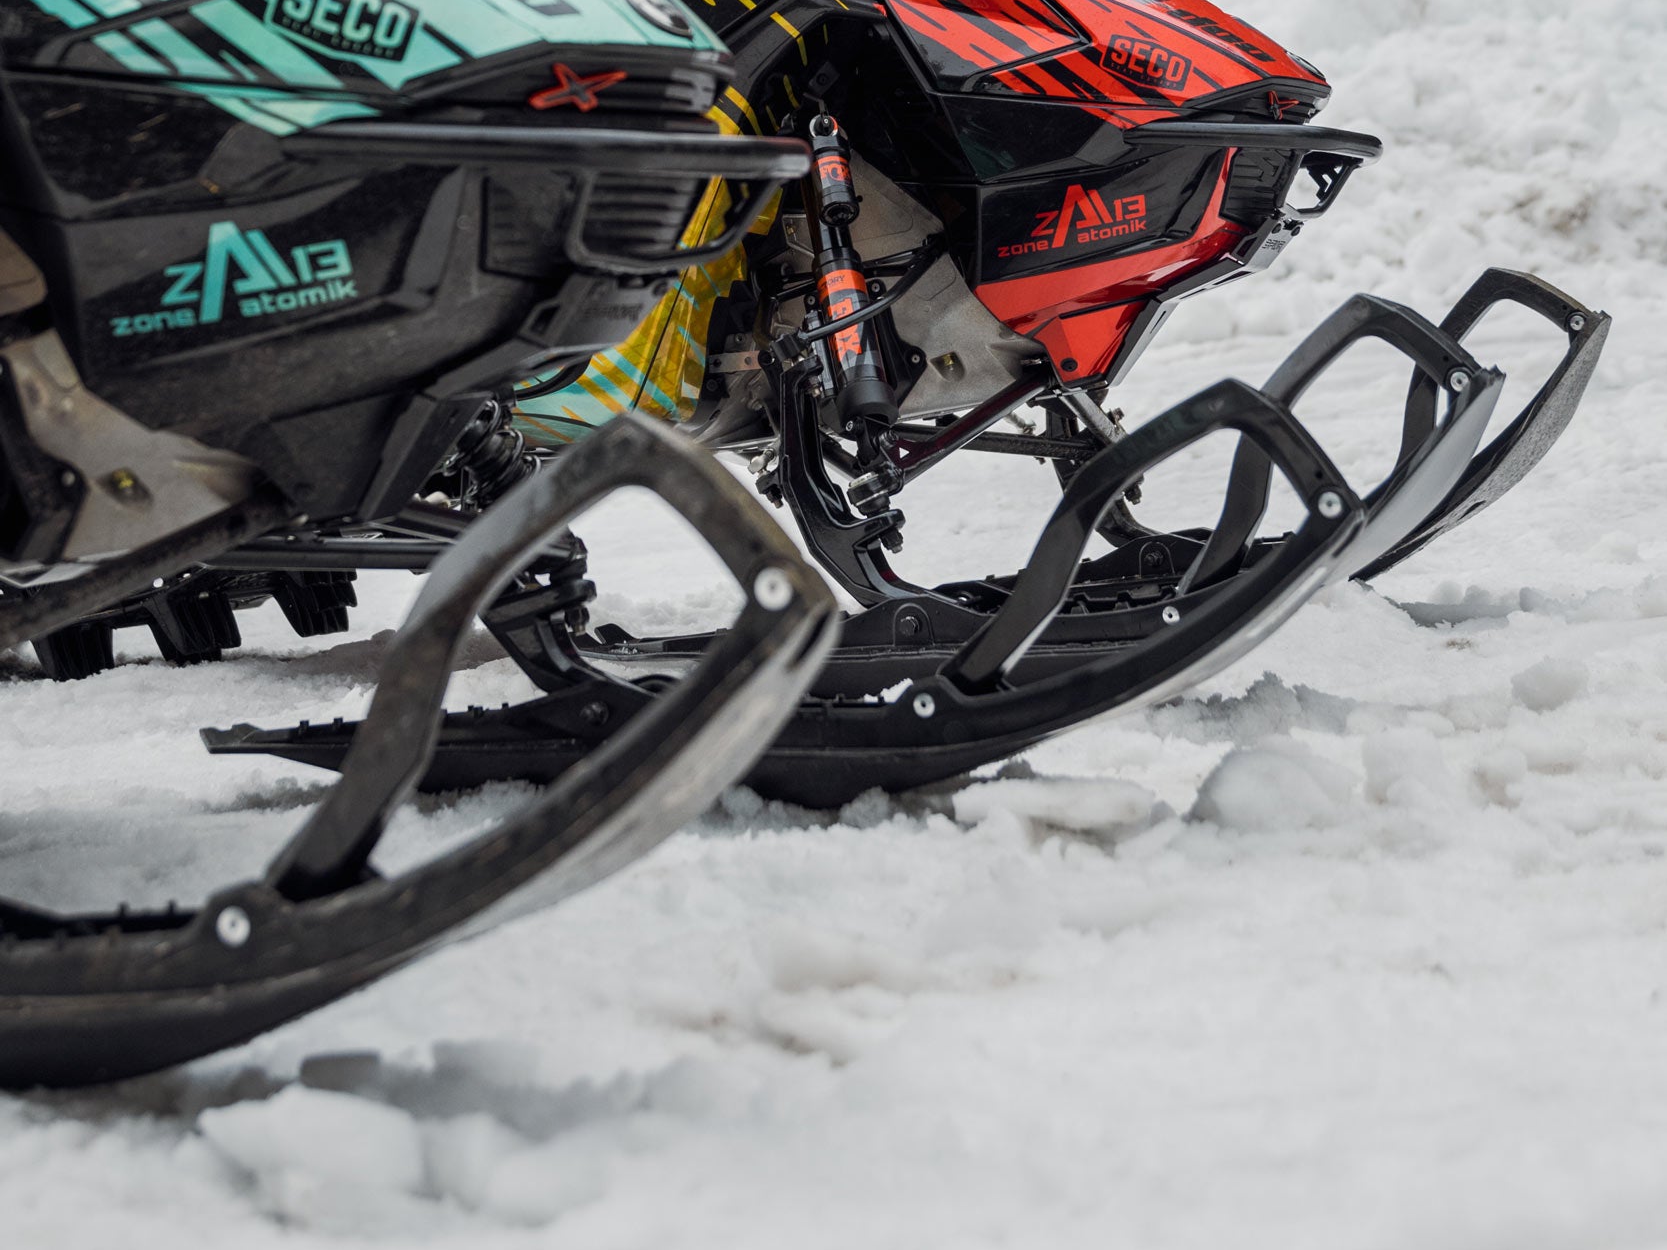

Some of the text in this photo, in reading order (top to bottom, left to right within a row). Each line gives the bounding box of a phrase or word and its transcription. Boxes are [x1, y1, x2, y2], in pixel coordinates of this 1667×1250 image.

[1111, 38, 1186, 82] SECO
[997, 219, 1147, 257] zone atomik
[109, 279, 359, 337] zone atomik
